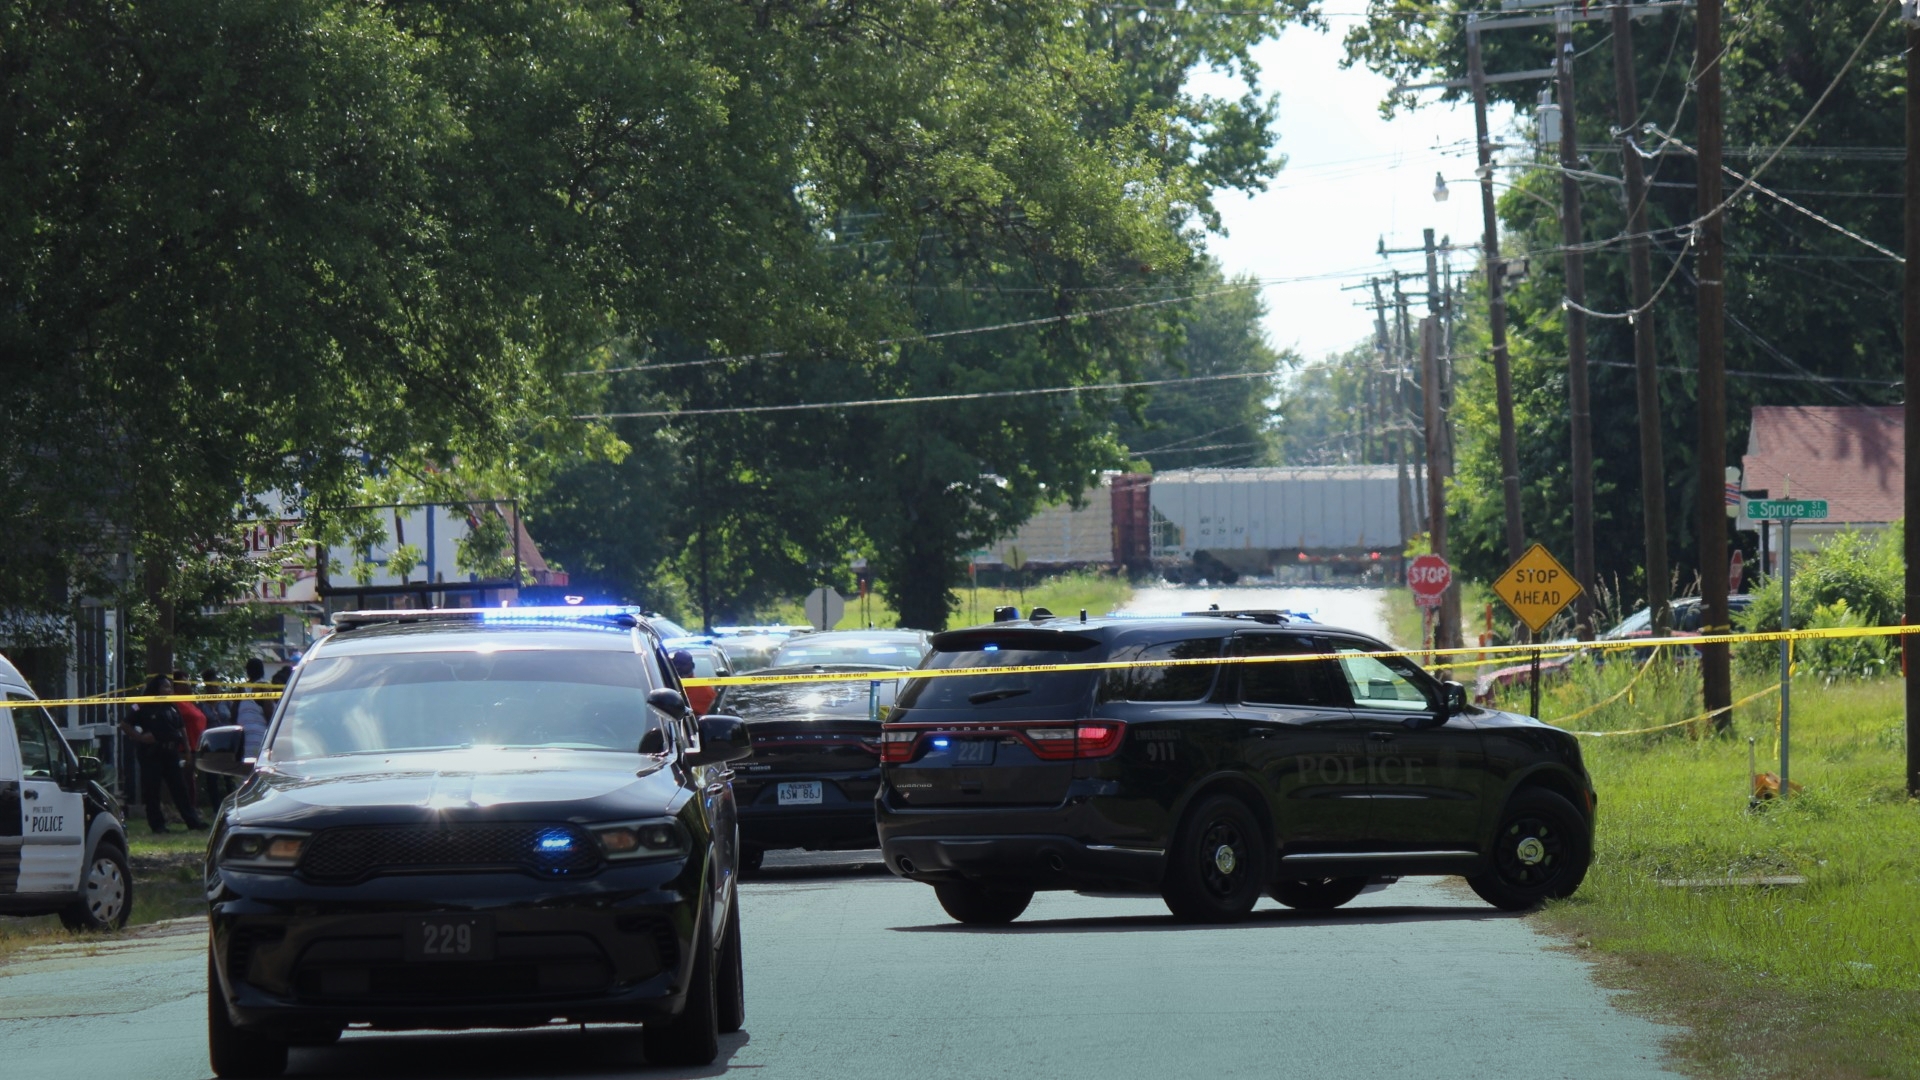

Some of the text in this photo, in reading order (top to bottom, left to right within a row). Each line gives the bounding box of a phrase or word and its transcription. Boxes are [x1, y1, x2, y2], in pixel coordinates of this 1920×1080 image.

[1760, 502, 1805, 518] Spruce
[1808, 509, 1826, 518] 1300
[1411, 566, 1448, 584] STOP
[1516, 569, 1559, 584] STOP
[1513, 590, 1561, 605] AHEAD
[958, 741, 984, 761] 221
[1146, 742, 1176, 761] 911
[1296, 755, 1426, 785] POLICE
[780, 789, 798, 800] ASW
[32, 816, 64, 832] POLICE
[423, 924, 472, 954] 229
